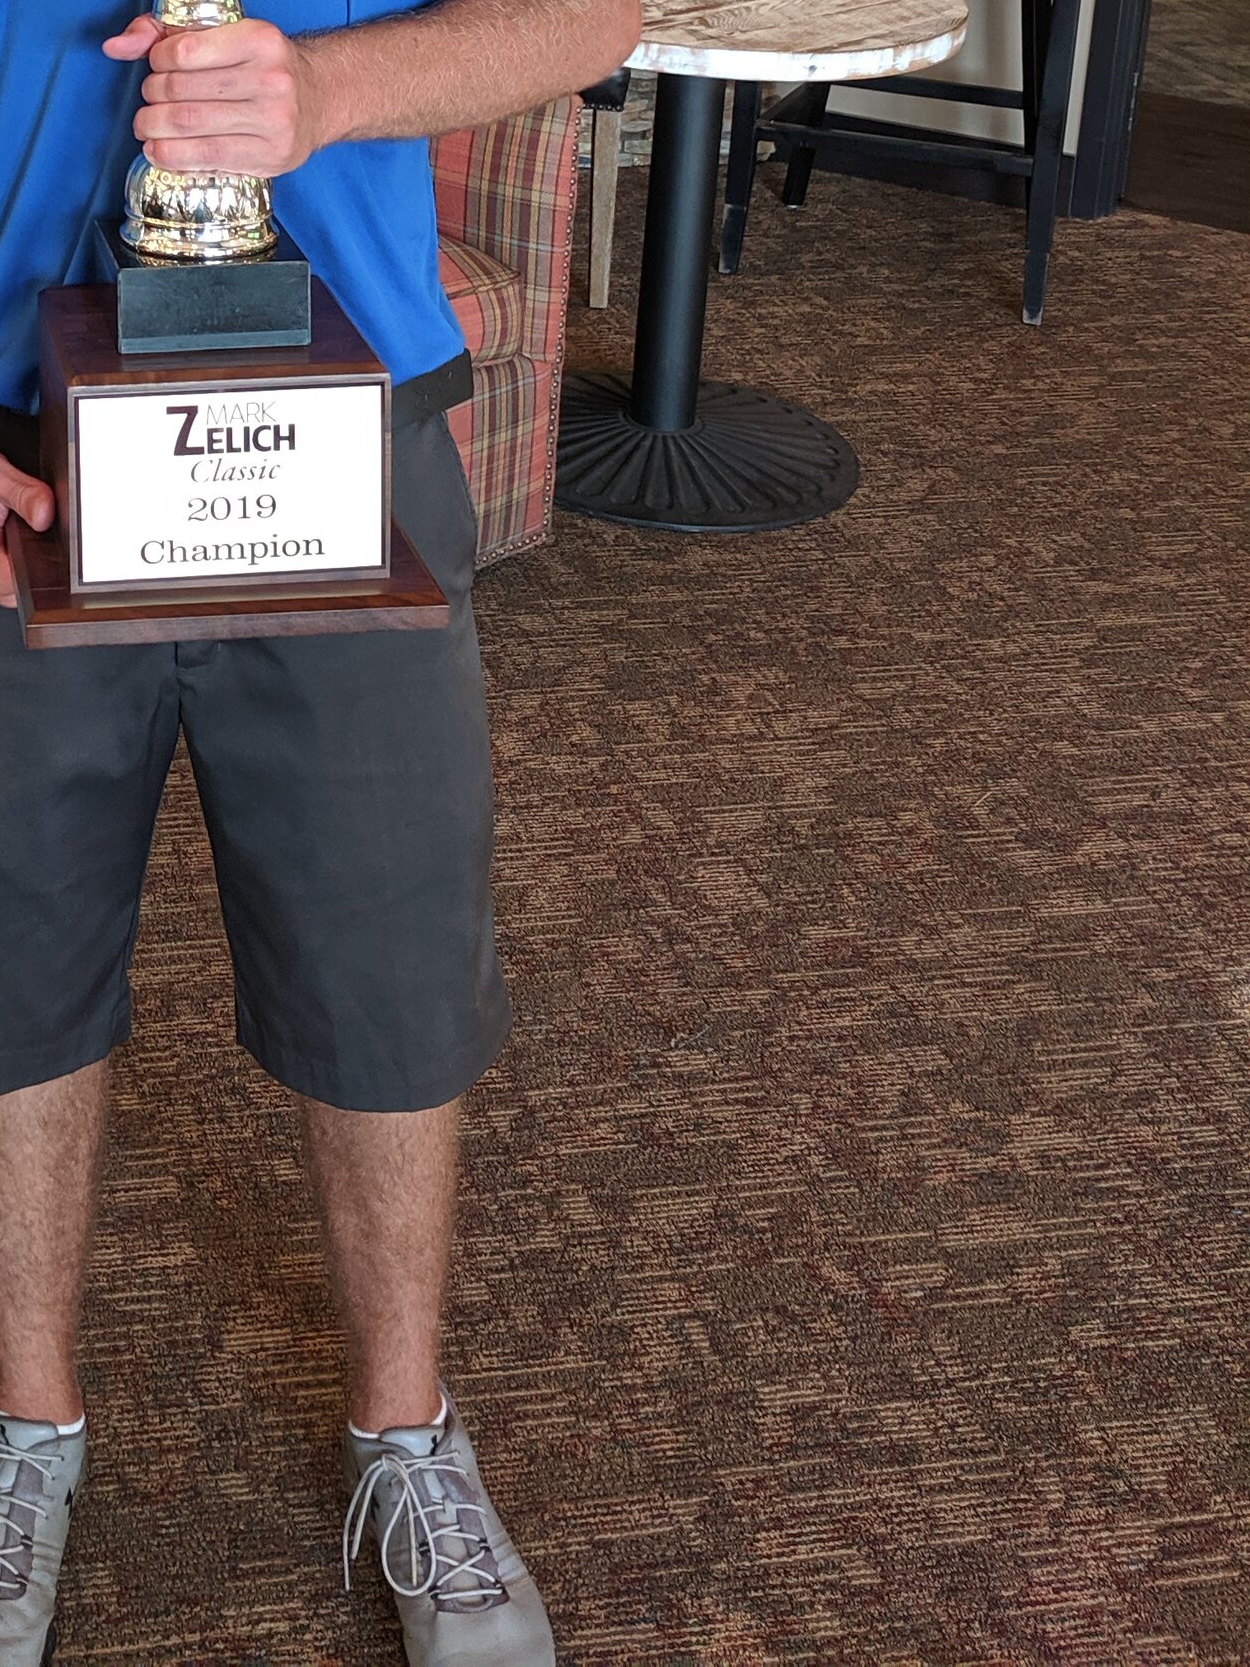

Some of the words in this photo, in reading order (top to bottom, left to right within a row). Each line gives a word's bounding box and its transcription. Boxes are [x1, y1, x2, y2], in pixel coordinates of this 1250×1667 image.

[206, 400, 277, 426] MARK
[165, 403, 296, 457] ZELICH
[190, 457, 282, 483] Classic
[187, 493, 278, 522] 2019
[140, 533, 326, 566] Champion
